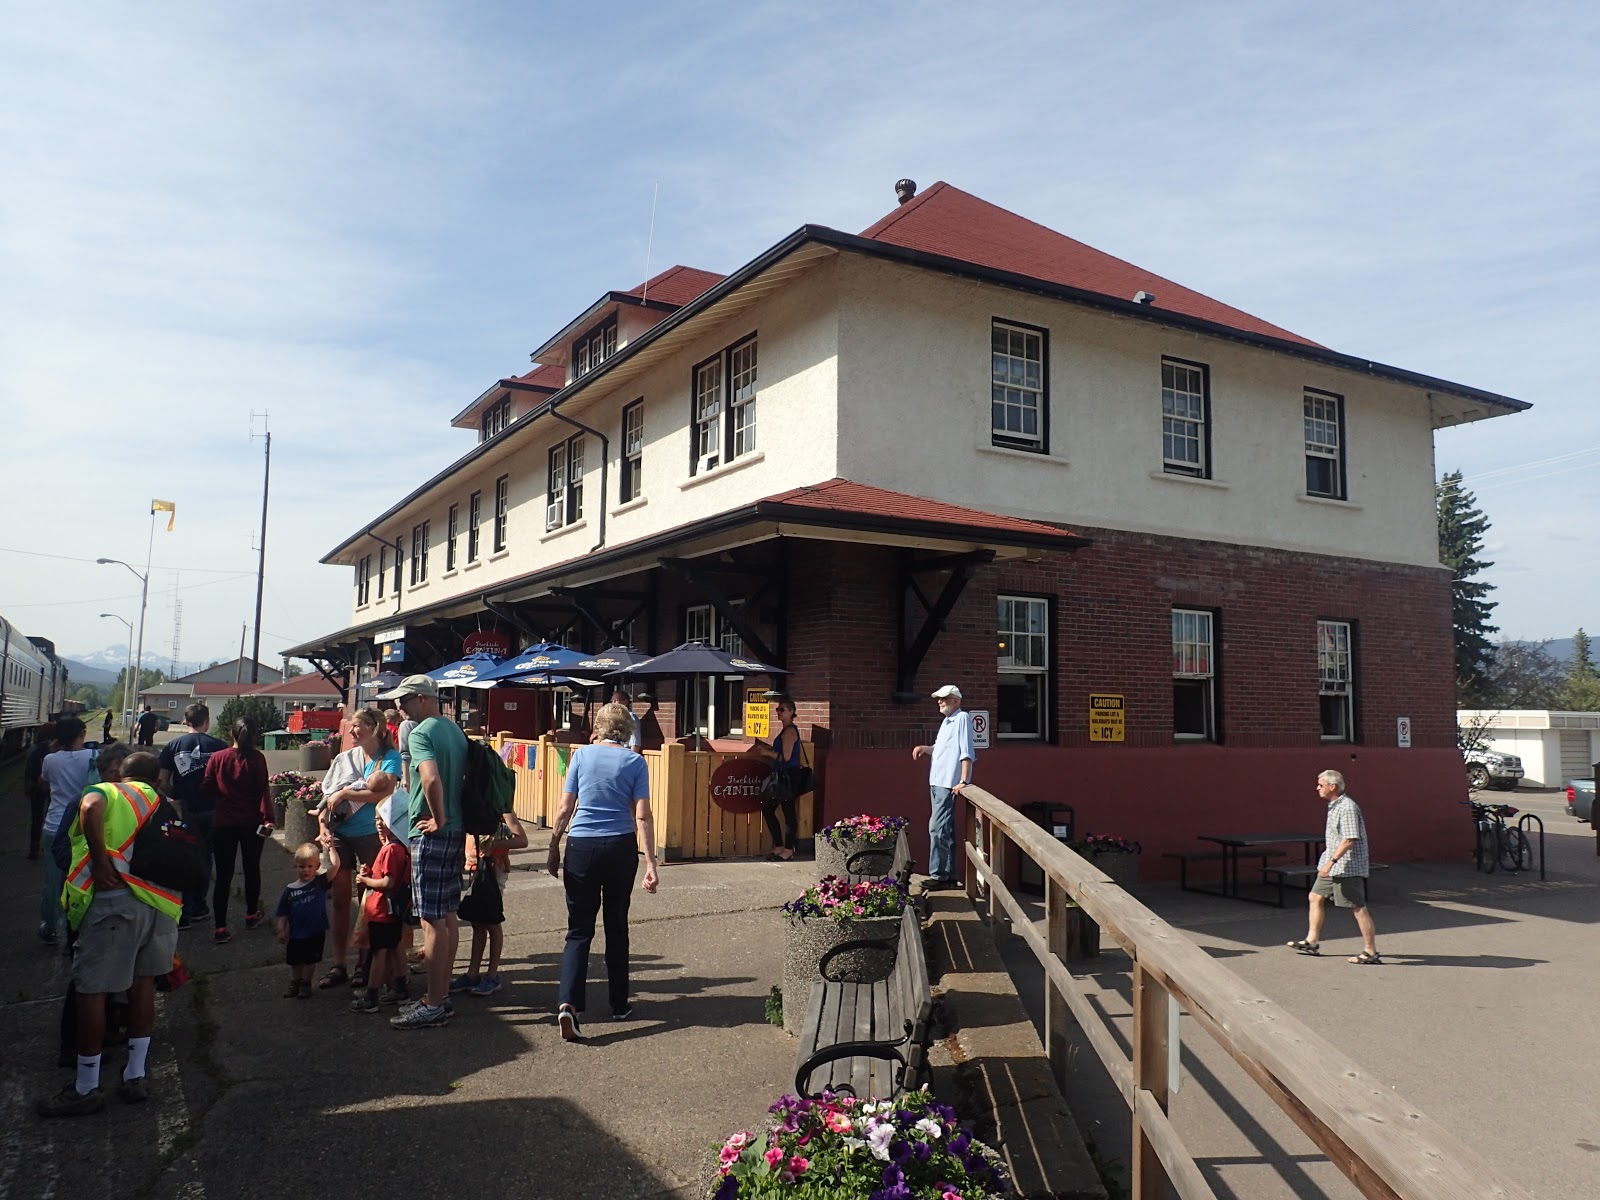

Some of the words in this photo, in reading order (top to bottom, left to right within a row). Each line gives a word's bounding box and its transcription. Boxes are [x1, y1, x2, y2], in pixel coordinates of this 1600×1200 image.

[1094, 698, 1120, 708] CAUTION
[754, 722, 762, 734] ICY
[1101, 727, 1113, 739] ICY
[728, 775, 761, 784] Trackside
